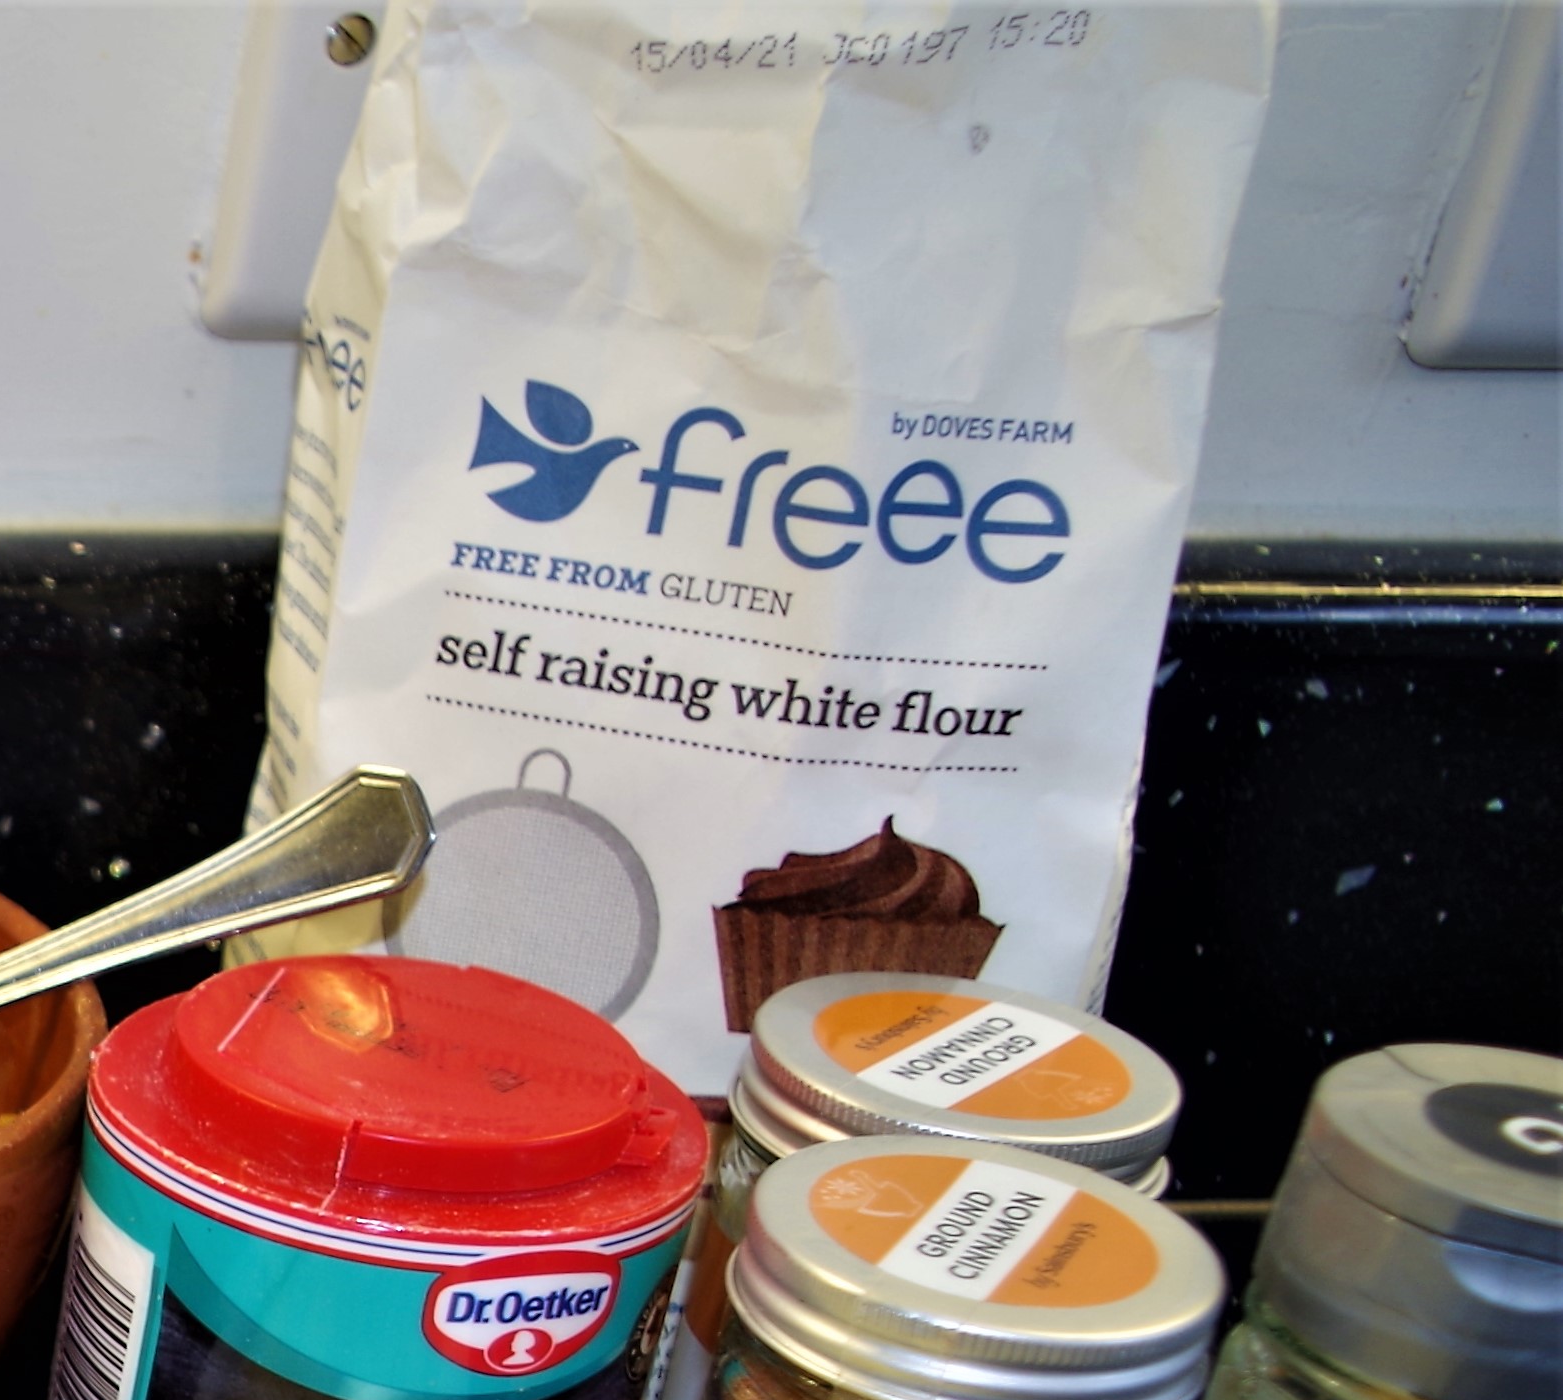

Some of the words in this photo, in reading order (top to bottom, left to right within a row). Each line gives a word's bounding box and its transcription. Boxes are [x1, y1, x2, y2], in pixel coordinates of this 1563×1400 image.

[630, 31, 799, 73] 15/04/21
[987, 10, 1090, 51] 15:20
[892, 412, 918, 439] by
[922, 414, 994, 441] DOVES
[997, 420, 1074, 445] FARM
[639, 406, 1071, 583] freee
[450, 540, 539, 578] FREE
[546, 557, 650, 595] FROM
[660, 573, 794, 617] GLUTEN
[435, 629, 530, 677] self
[535, 648, 718, 721] raising
[732, 679, 881, 730] white
[890, 689, 1024, 738] flour
[890, 1017, 1014, 1081] CINNAMON
[940, 1034, 1036, 1086] GROUND
[917, 1190, 995, 1259] GROUND
[948, 1192, 1046, 1280] CINNAMON
